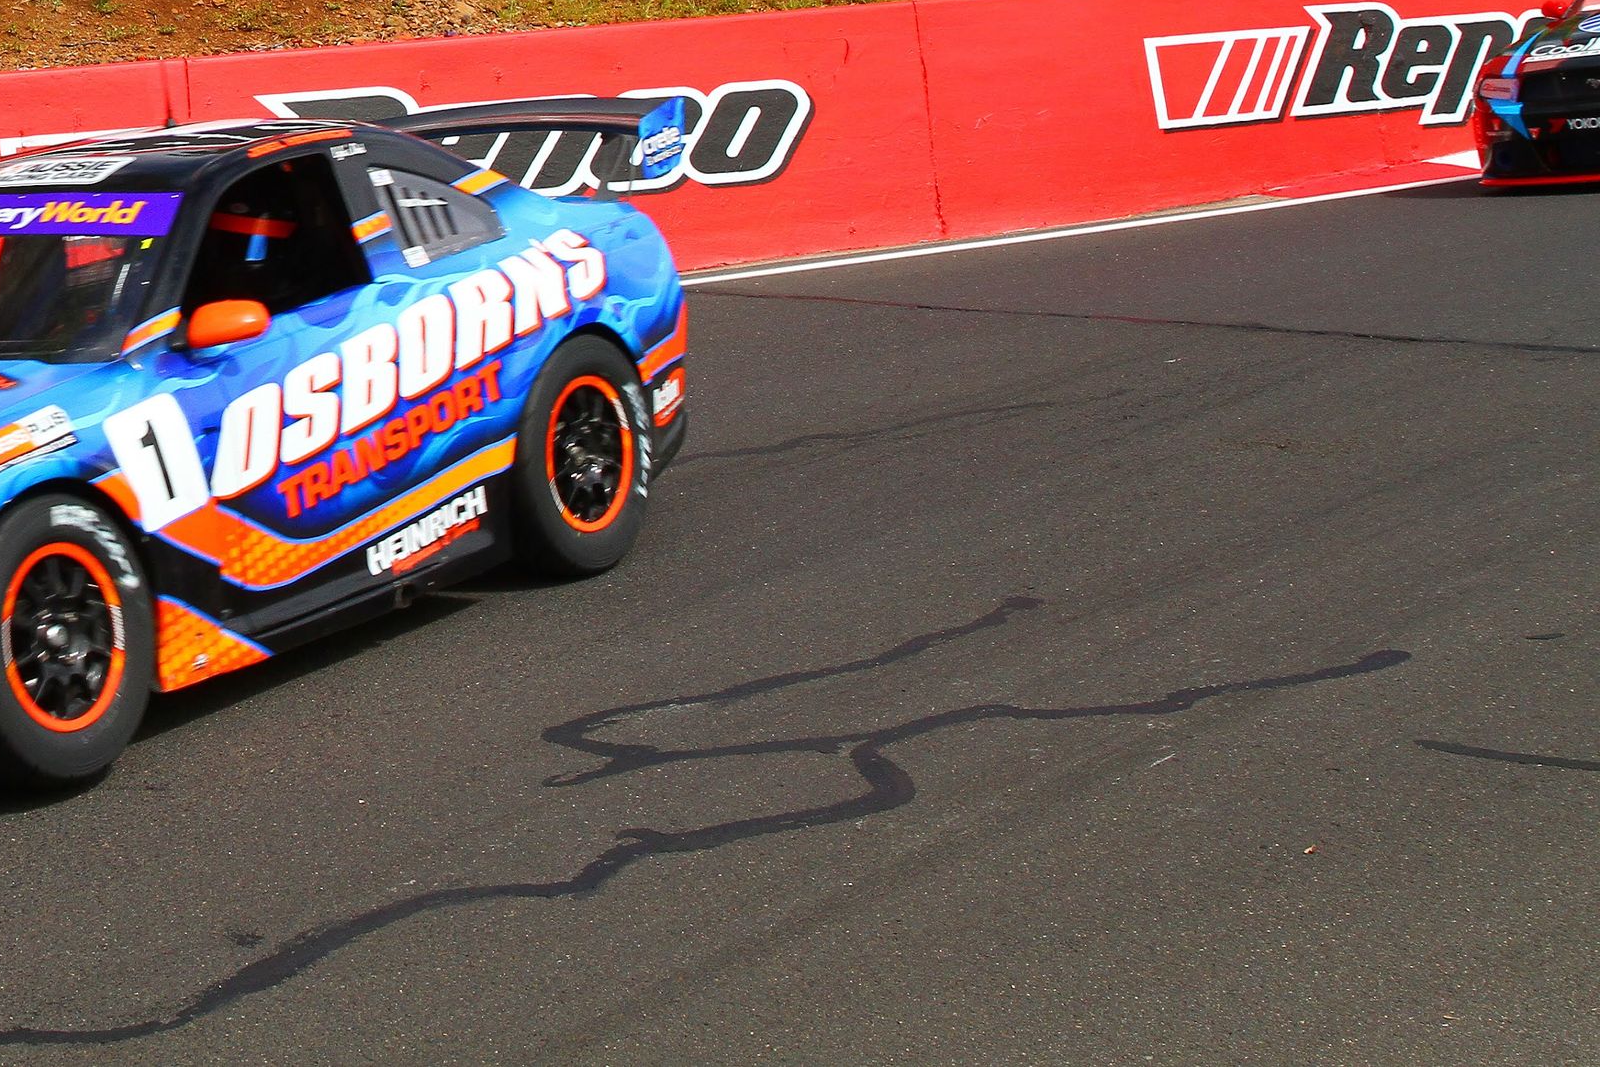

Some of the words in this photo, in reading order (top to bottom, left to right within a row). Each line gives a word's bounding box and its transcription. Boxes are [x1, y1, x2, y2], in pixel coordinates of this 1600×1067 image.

[1290, 1, 1550, 126] Rep
[1567, 118, 1600, 130] YOKO
[211, 228, 607, 500] OSBORN'S
[138, 420, 175, 501] 1
[277, 360, 503, 519] TRANSPORT
[366, 485, 489, 576] HEINRICH
